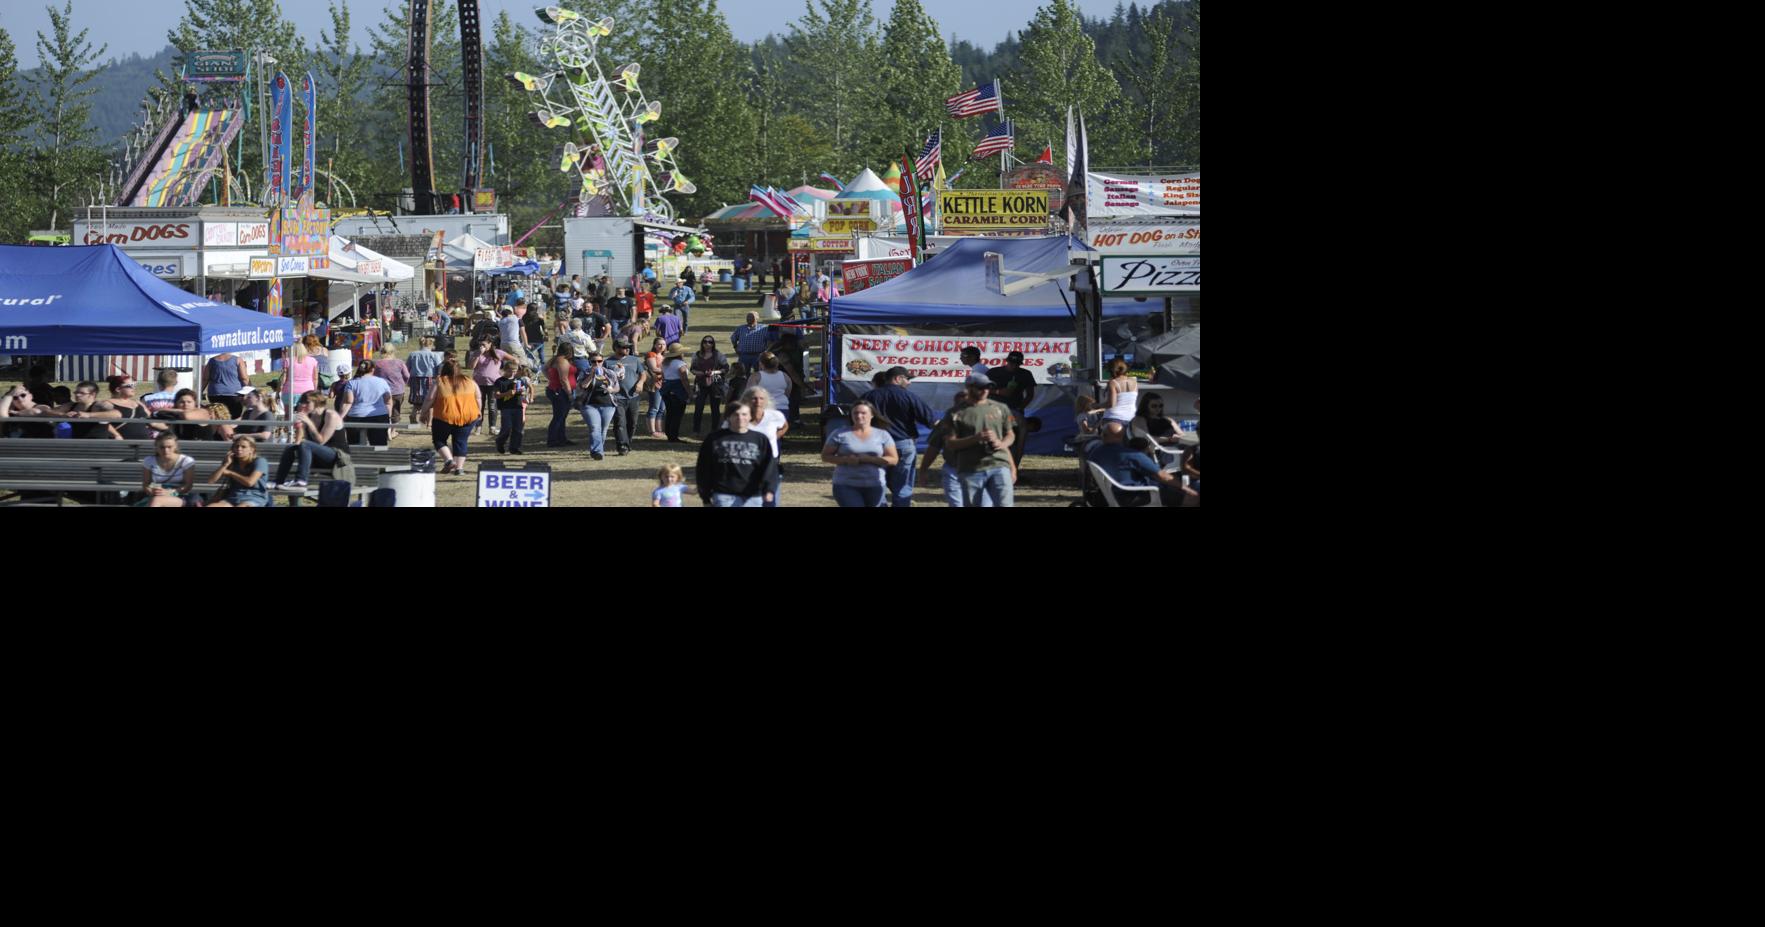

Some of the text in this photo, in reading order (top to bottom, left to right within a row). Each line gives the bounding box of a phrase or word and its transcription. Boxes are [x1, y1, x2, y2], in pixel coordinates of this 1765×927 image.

[943, 197, 1047, 213] KETTLE KORN
[944, 215, 1047, 225] CARAMEL CORN
[130, 224, 189, 241] DOGS
[1093, 233, 1127, 247] HOT
[1129, 229, 1163, 245] DOG
[0, 295, 55, 306] ural
[211, 328, 284, 348] nwnatural.com
[850, 339, 890, 351] BEEF
[992, 341, 1071, 354] TERIYAKI
[876, 356, 949, 366] VEGGIES
[485, 474, 544, 490] BEER
[509, 490, 518, 499] &
